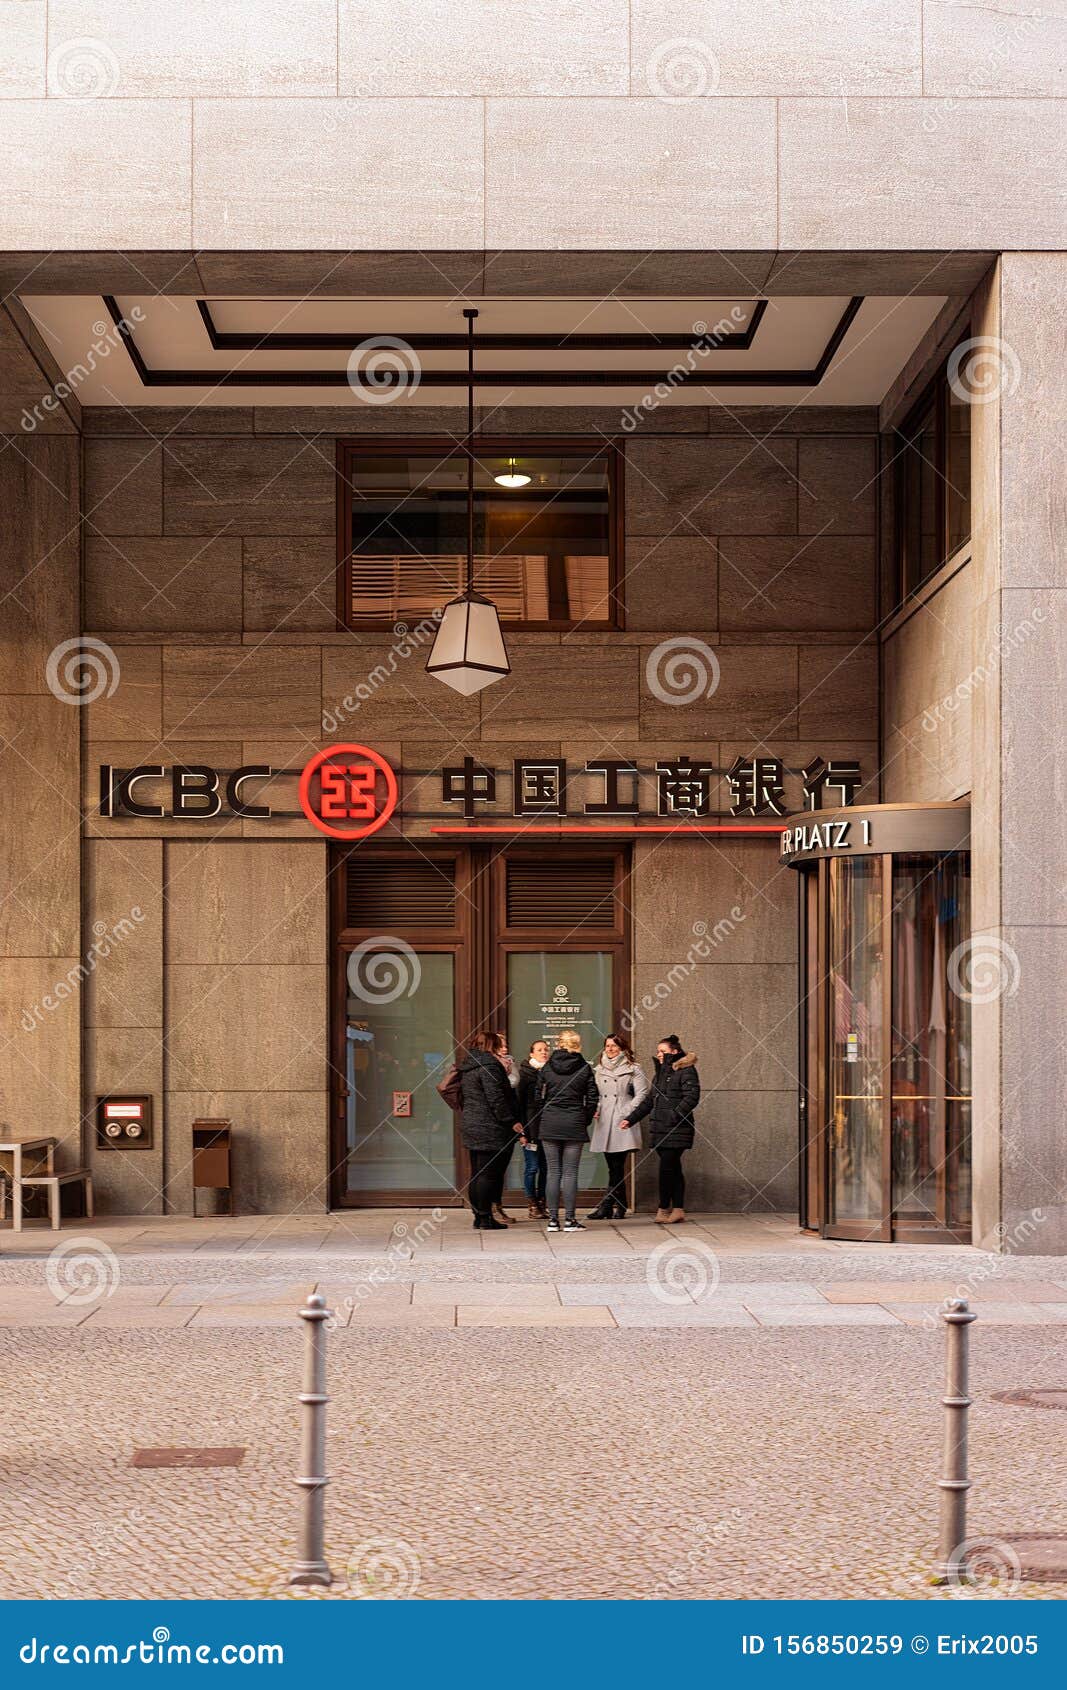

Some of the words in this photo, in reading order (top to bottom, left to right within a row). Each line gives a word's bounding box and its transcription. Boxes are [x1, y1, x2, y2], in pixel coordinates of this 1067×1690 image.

[99, 764, 272, 818] ICBC
[442, 756, 863, 818] 中国工商银行
[794, 821, 849, 851] PLATZ
[860, 819, 870, 845] 1
